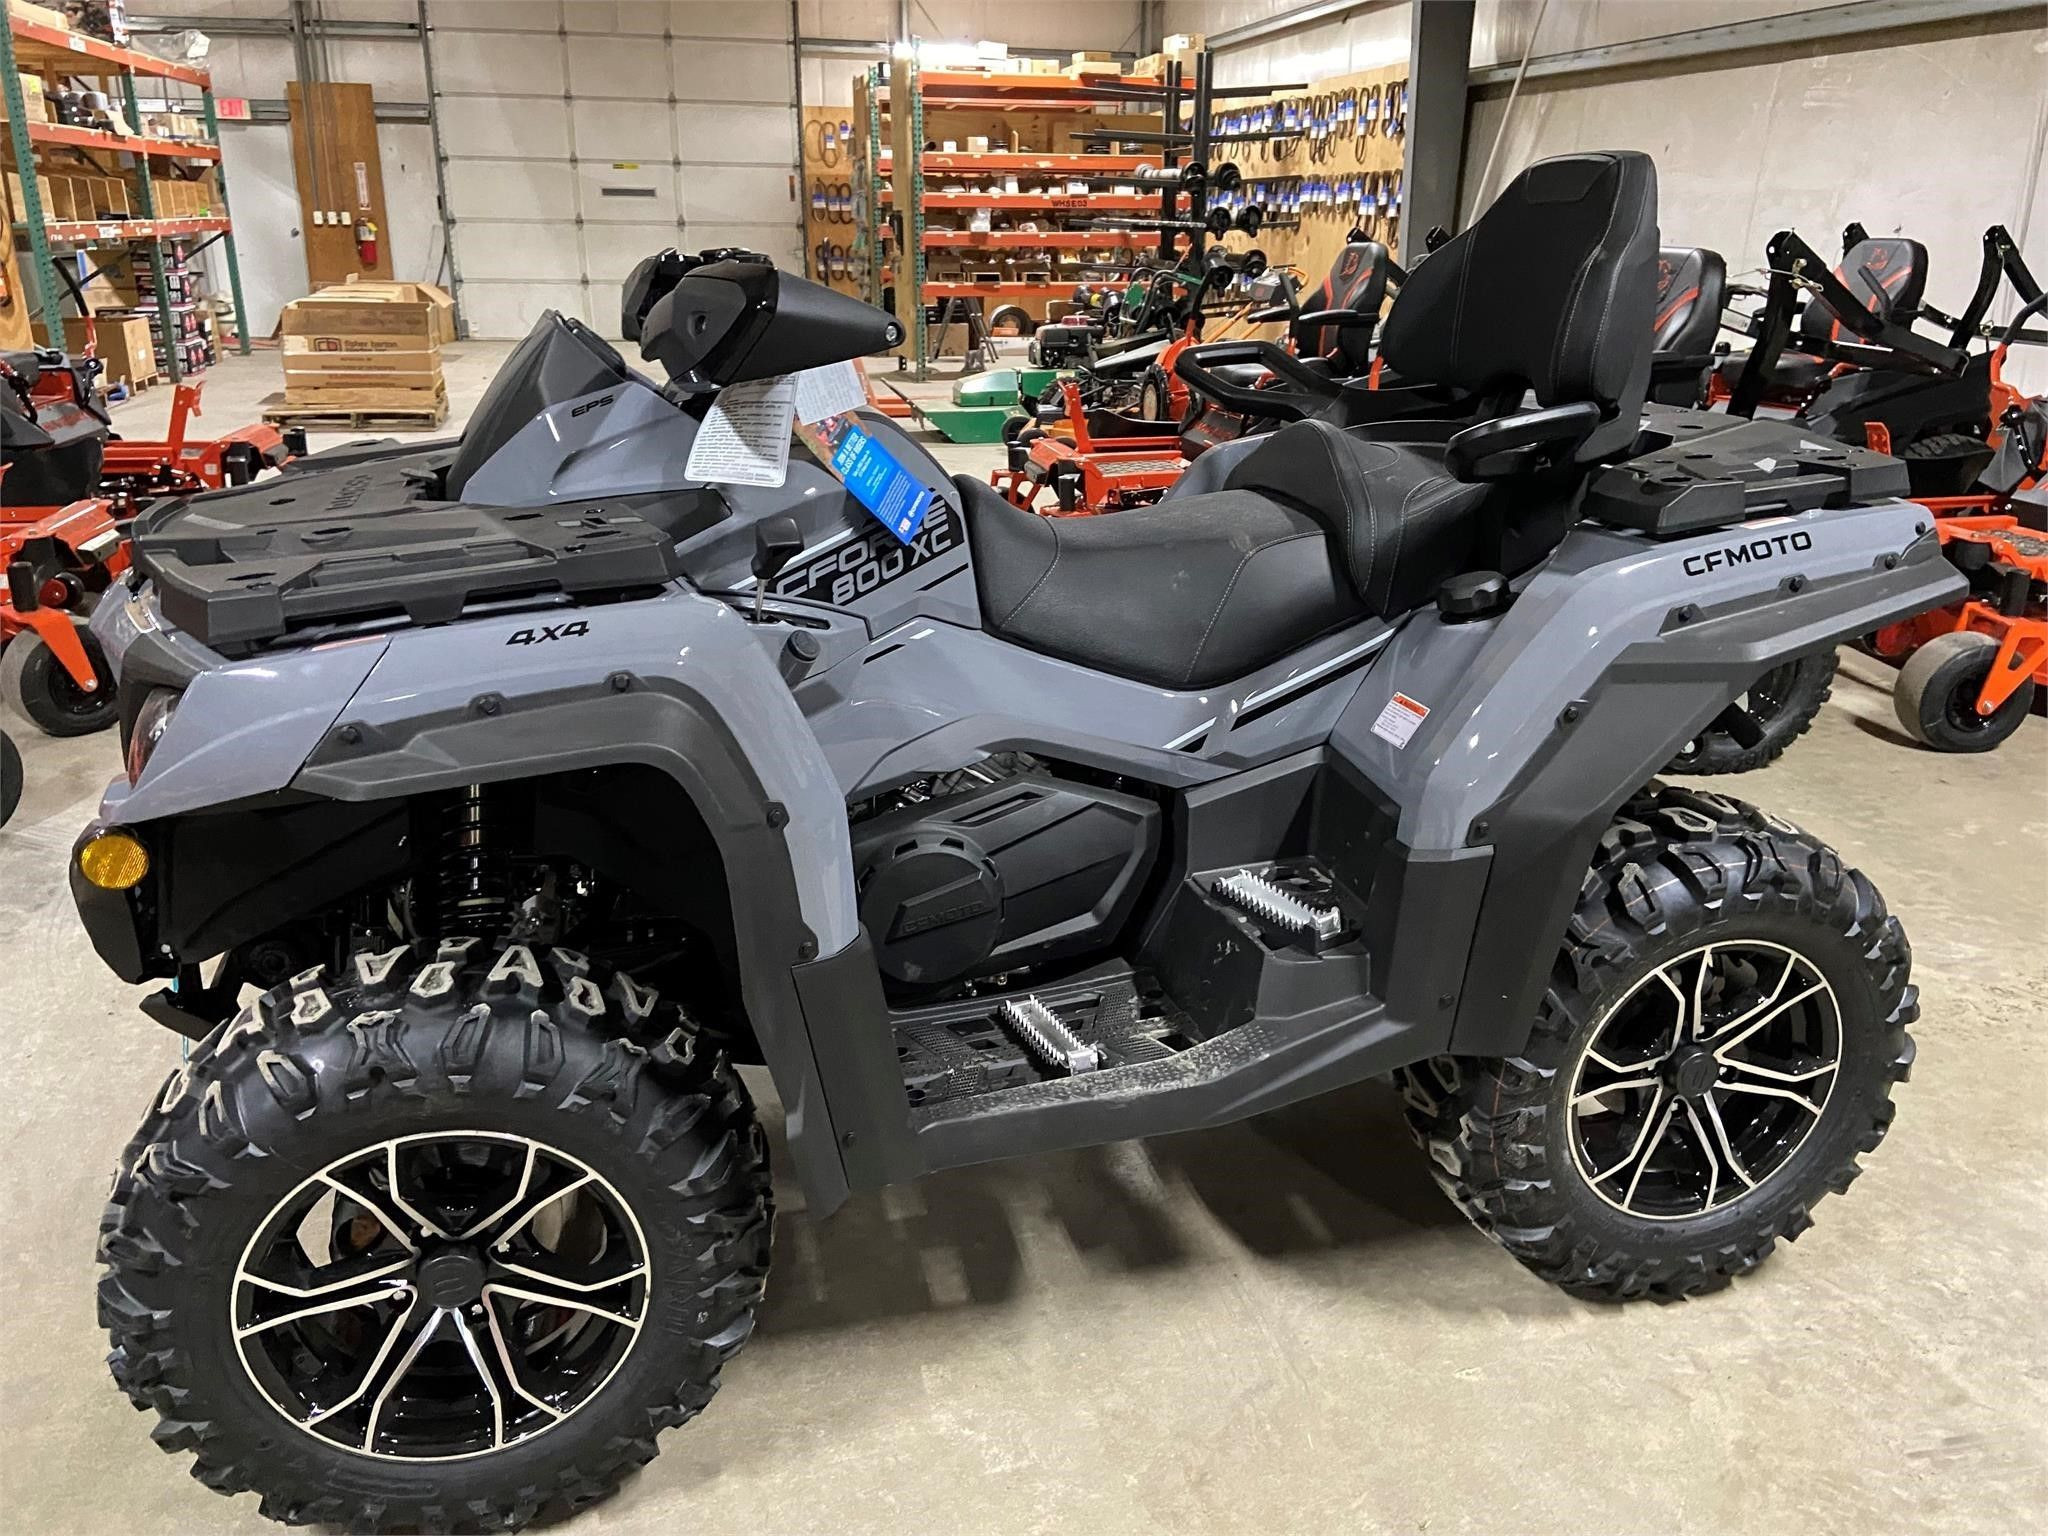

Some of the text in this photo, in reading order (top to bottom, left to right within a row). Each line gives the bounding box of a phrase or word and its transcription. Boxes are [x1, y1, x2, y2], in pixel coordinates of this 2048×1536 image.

[571, 394, 614, 418] EPS
[832, 523, 951, 605] 800 XC
[1682, 531, 1812, 576] CFMOTO
